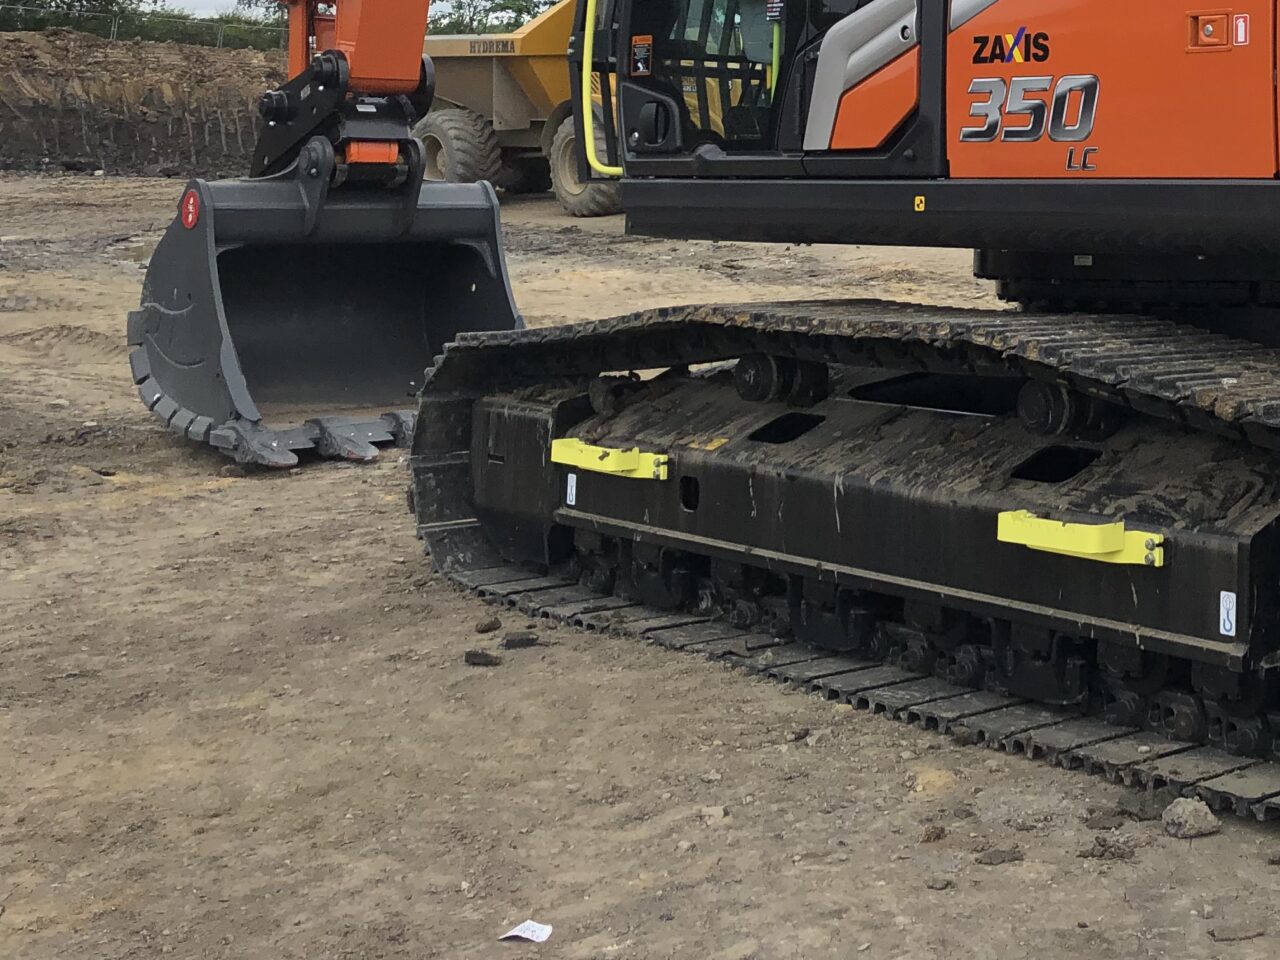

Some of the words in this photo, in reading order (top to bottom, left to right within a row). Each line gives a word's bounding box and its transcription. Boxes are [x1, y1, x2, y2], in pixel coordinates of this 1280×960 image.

[469, 41, 516, 54] HYDREMA
[972, 26, 1050, 64] ZAXIS
[959, 73, 1100, 143] 350
[1065, 146, 1099, 171] LC
